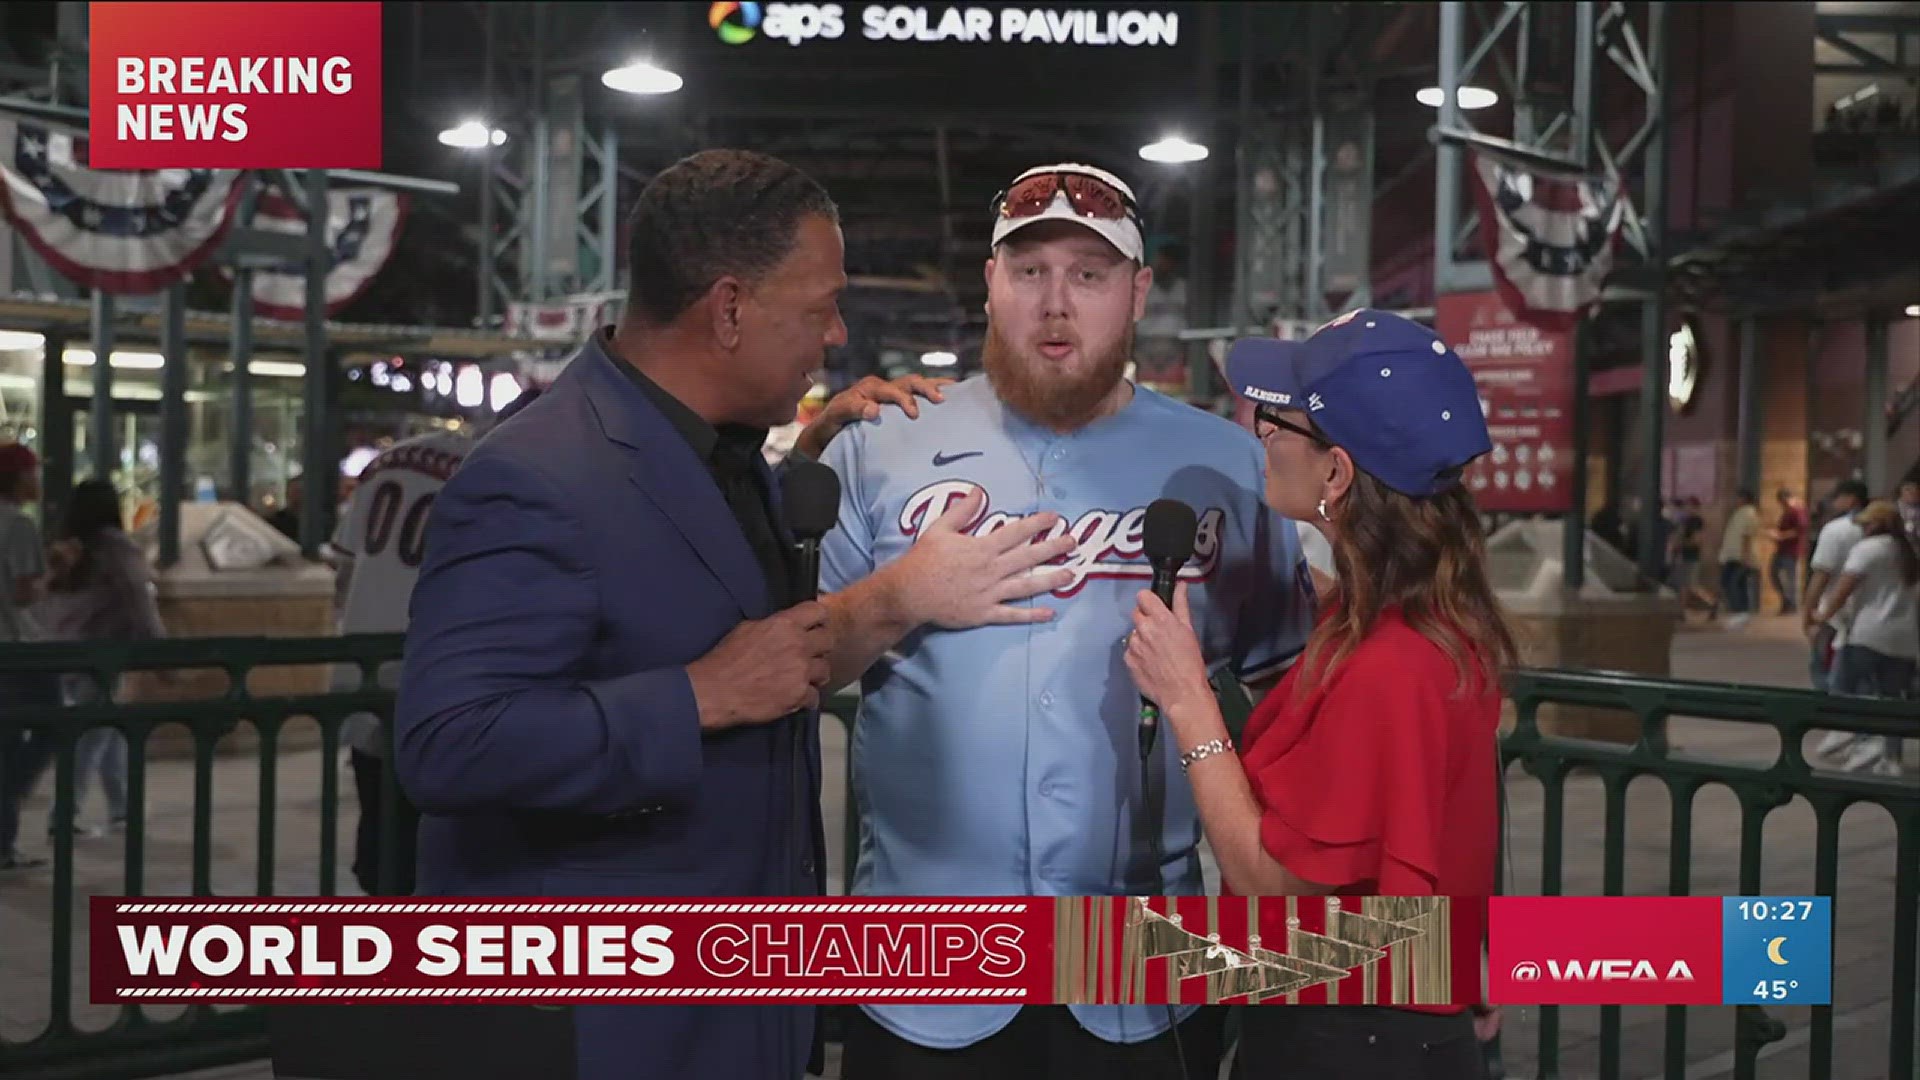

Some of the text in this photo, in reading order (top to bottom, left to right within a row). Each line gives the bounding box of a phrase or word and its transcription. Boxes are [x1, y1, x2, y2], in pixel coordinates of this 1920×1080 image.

[763, 3, 1178, 46] aps SOLAR PAVILION
[1243, 385, 1292, 405] RANGERS
[899, 478, 1225, 597] Rges
